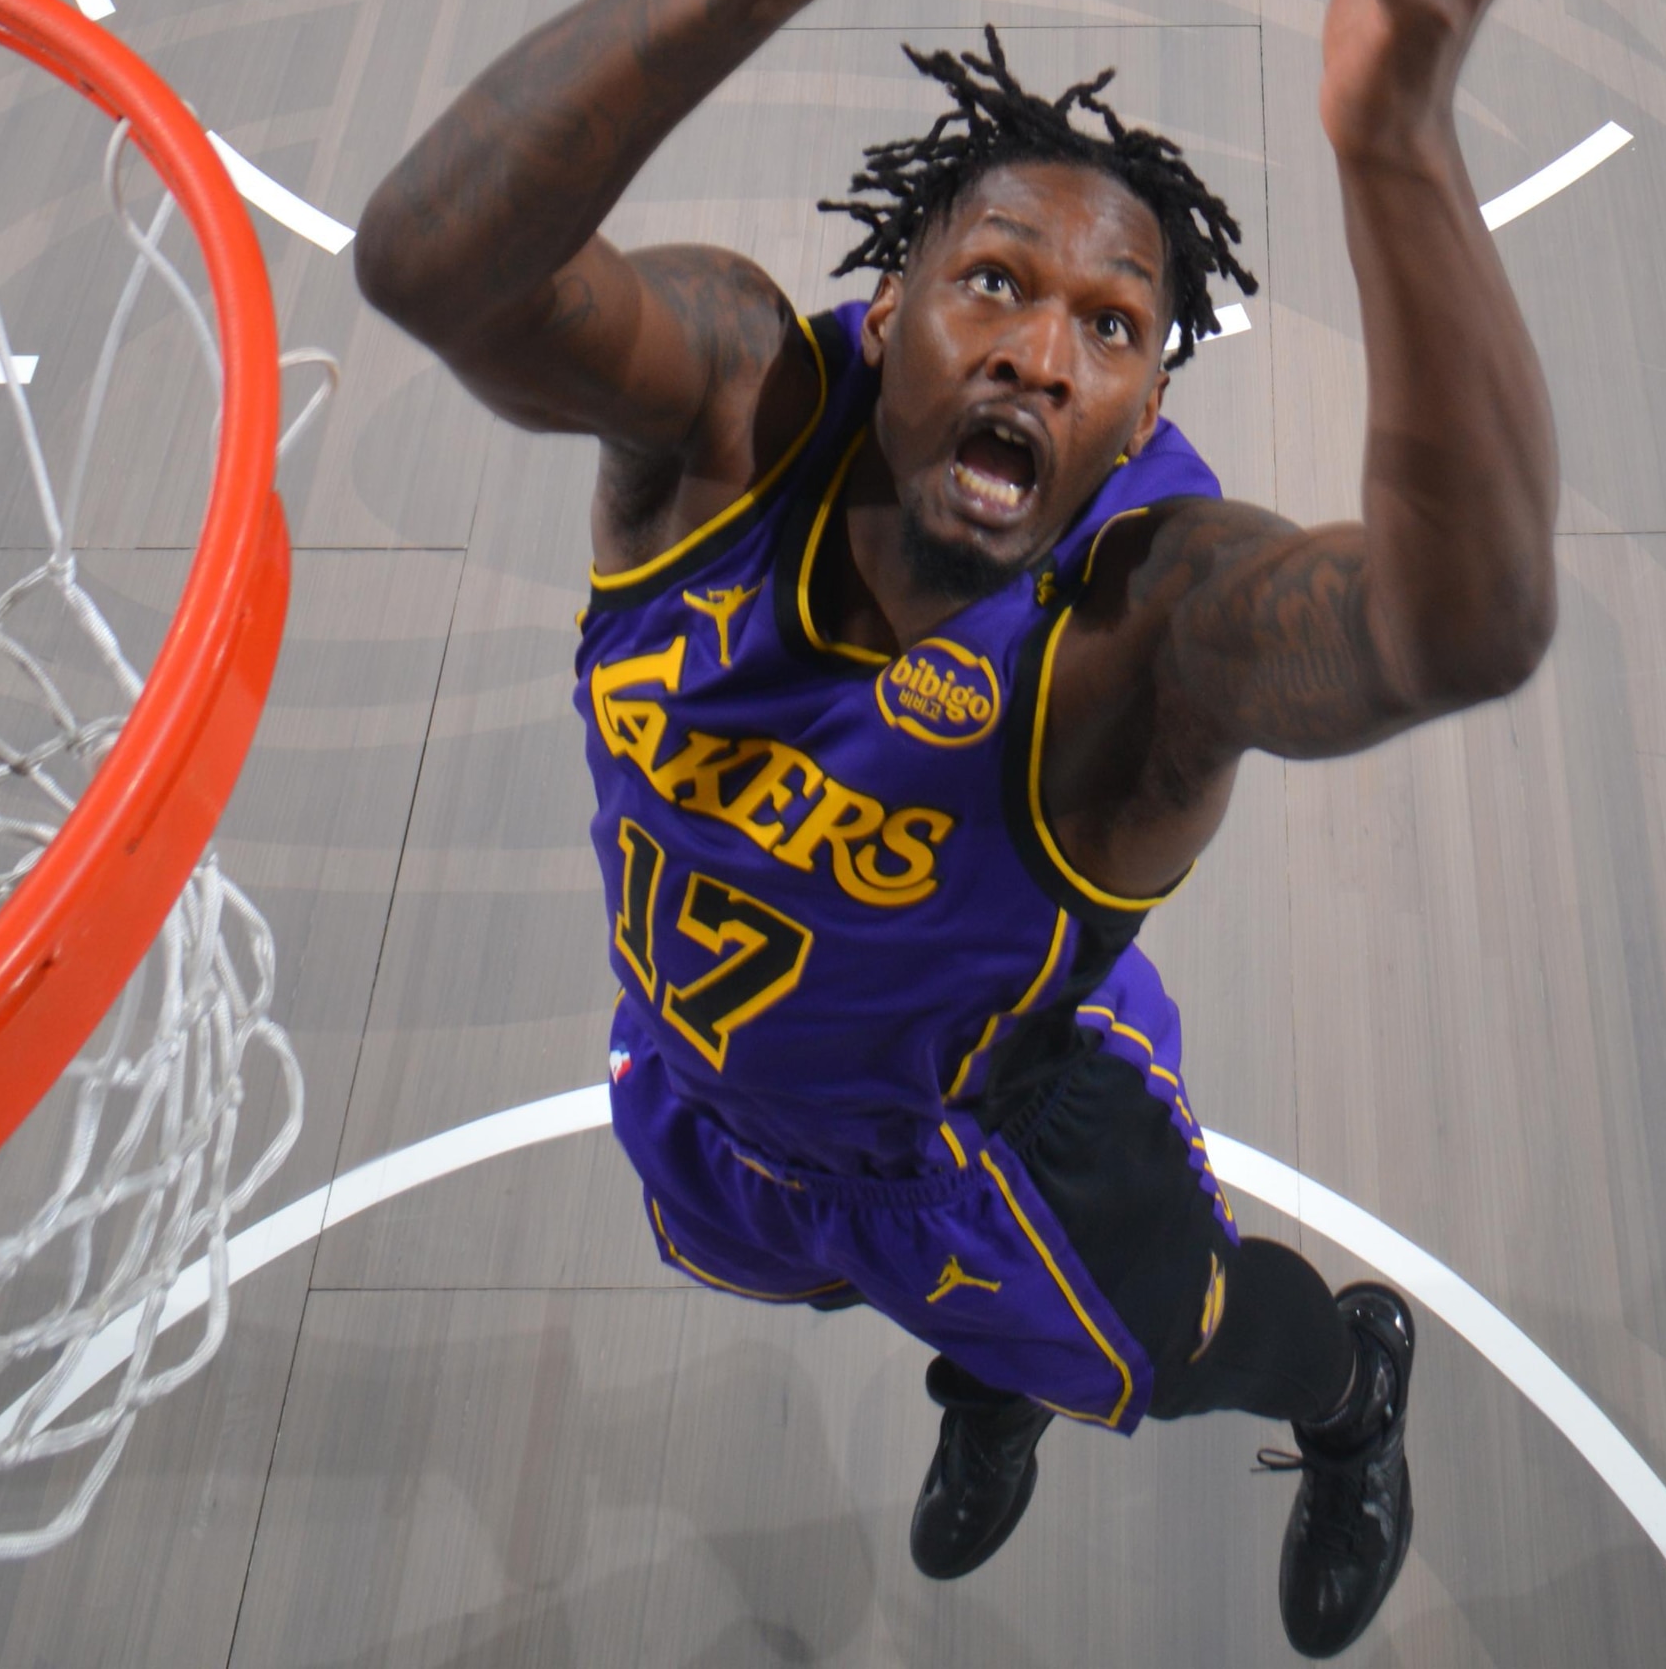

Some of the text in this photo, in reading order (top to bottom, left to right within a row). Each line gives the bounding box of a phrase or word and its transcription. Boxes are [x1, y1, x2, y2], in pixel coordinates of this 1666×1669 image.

[590, 635, 955, 908] LAKERS
[889, 653, 992, 725] bibigo
[614, 815, 814, 1073] 17
